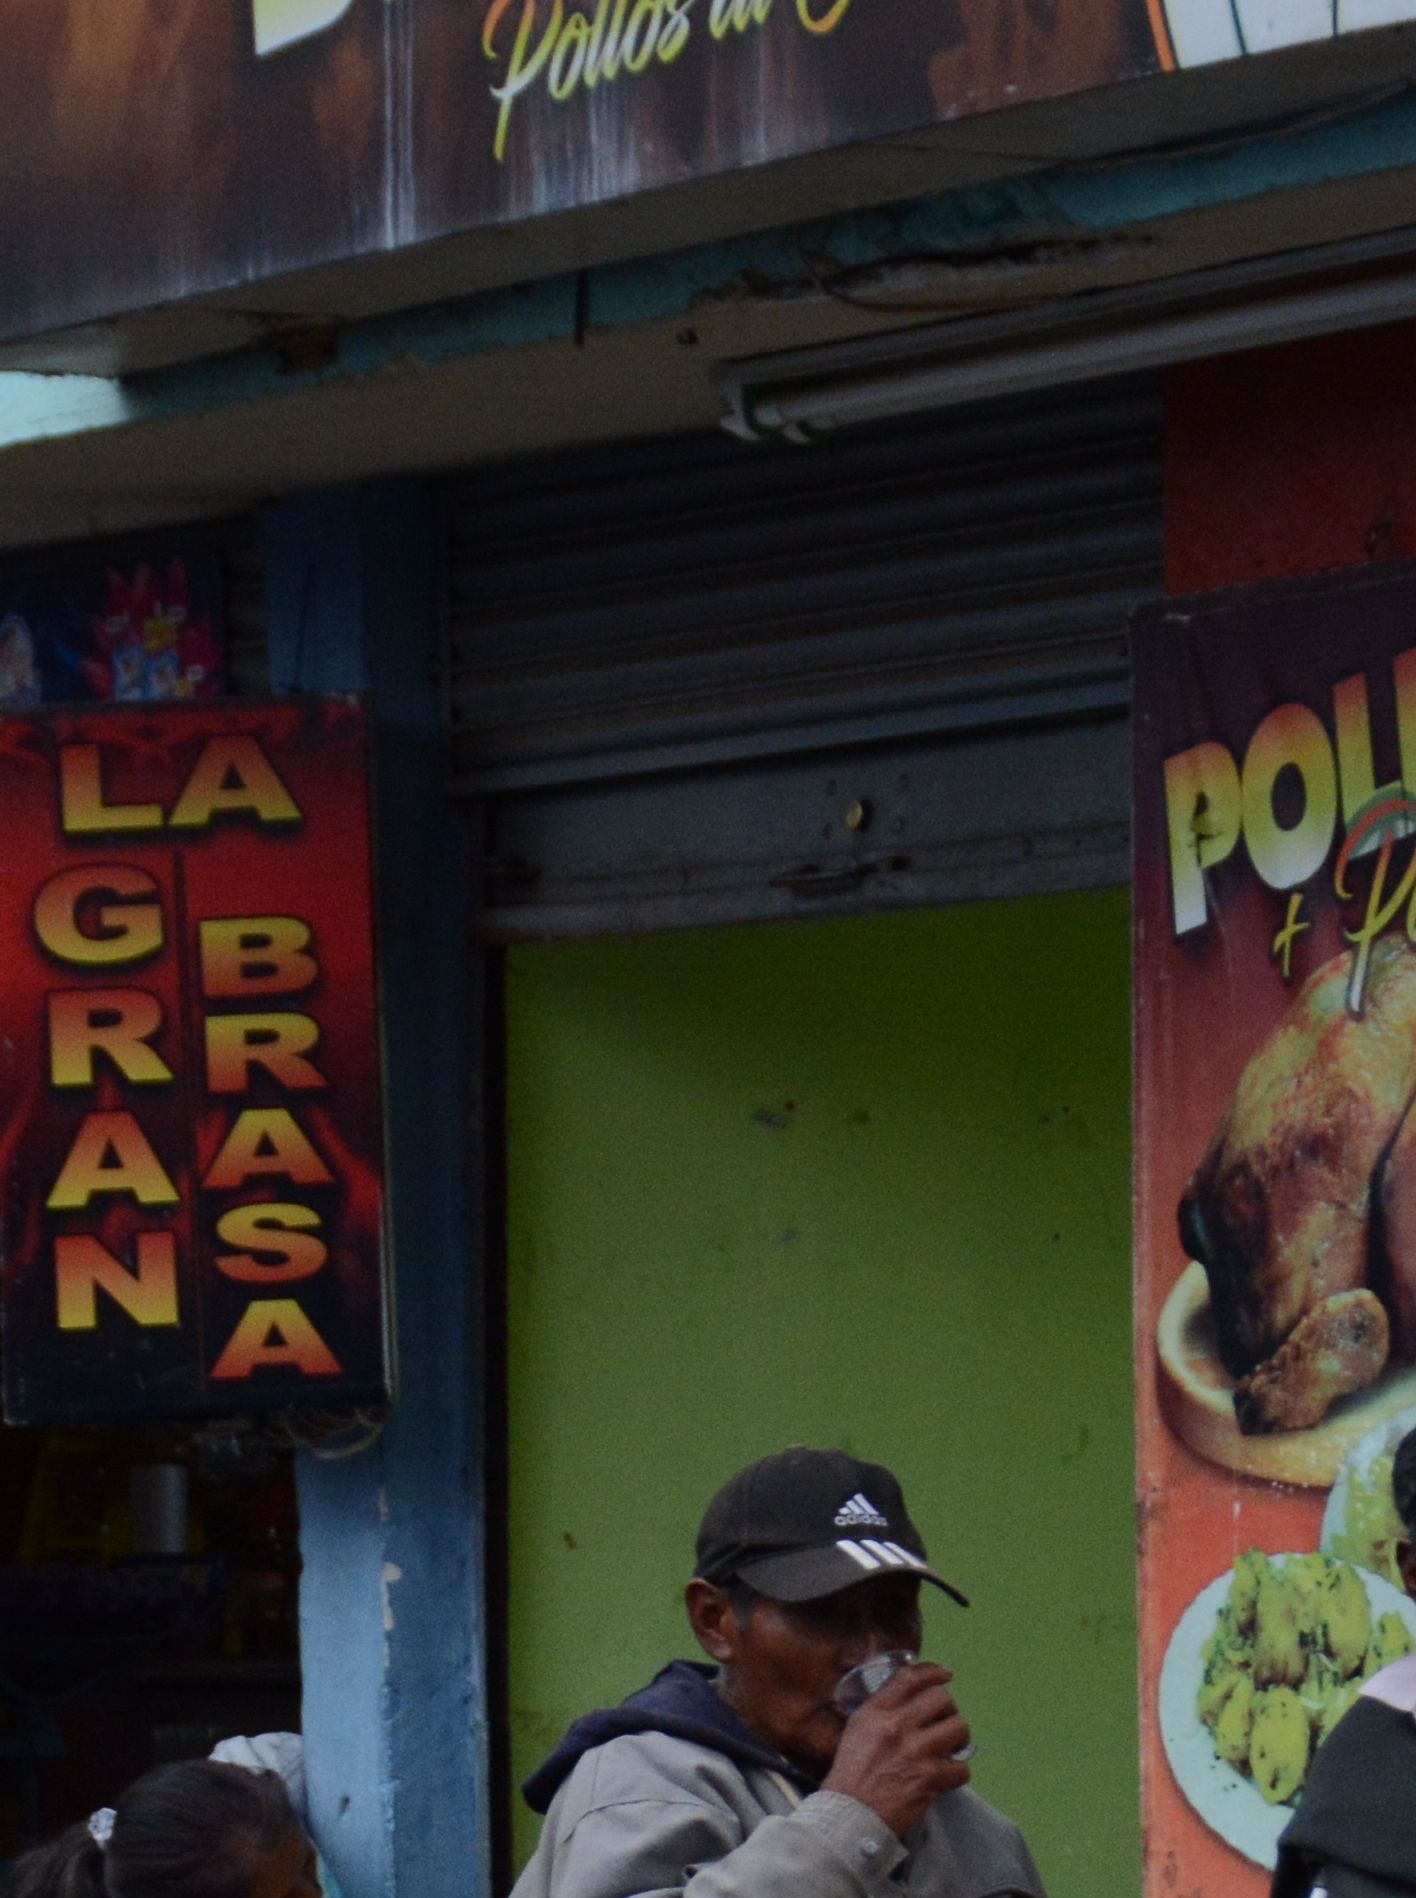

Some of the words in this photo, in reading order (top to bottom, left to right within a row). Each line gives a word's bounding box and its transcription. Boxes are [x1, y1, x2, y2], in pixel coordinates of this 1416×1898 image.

[60, 734, 302, 833] LA
[33, 863, 181, 1330] GRAN
[200, 916, 343, 1378] BRASA
